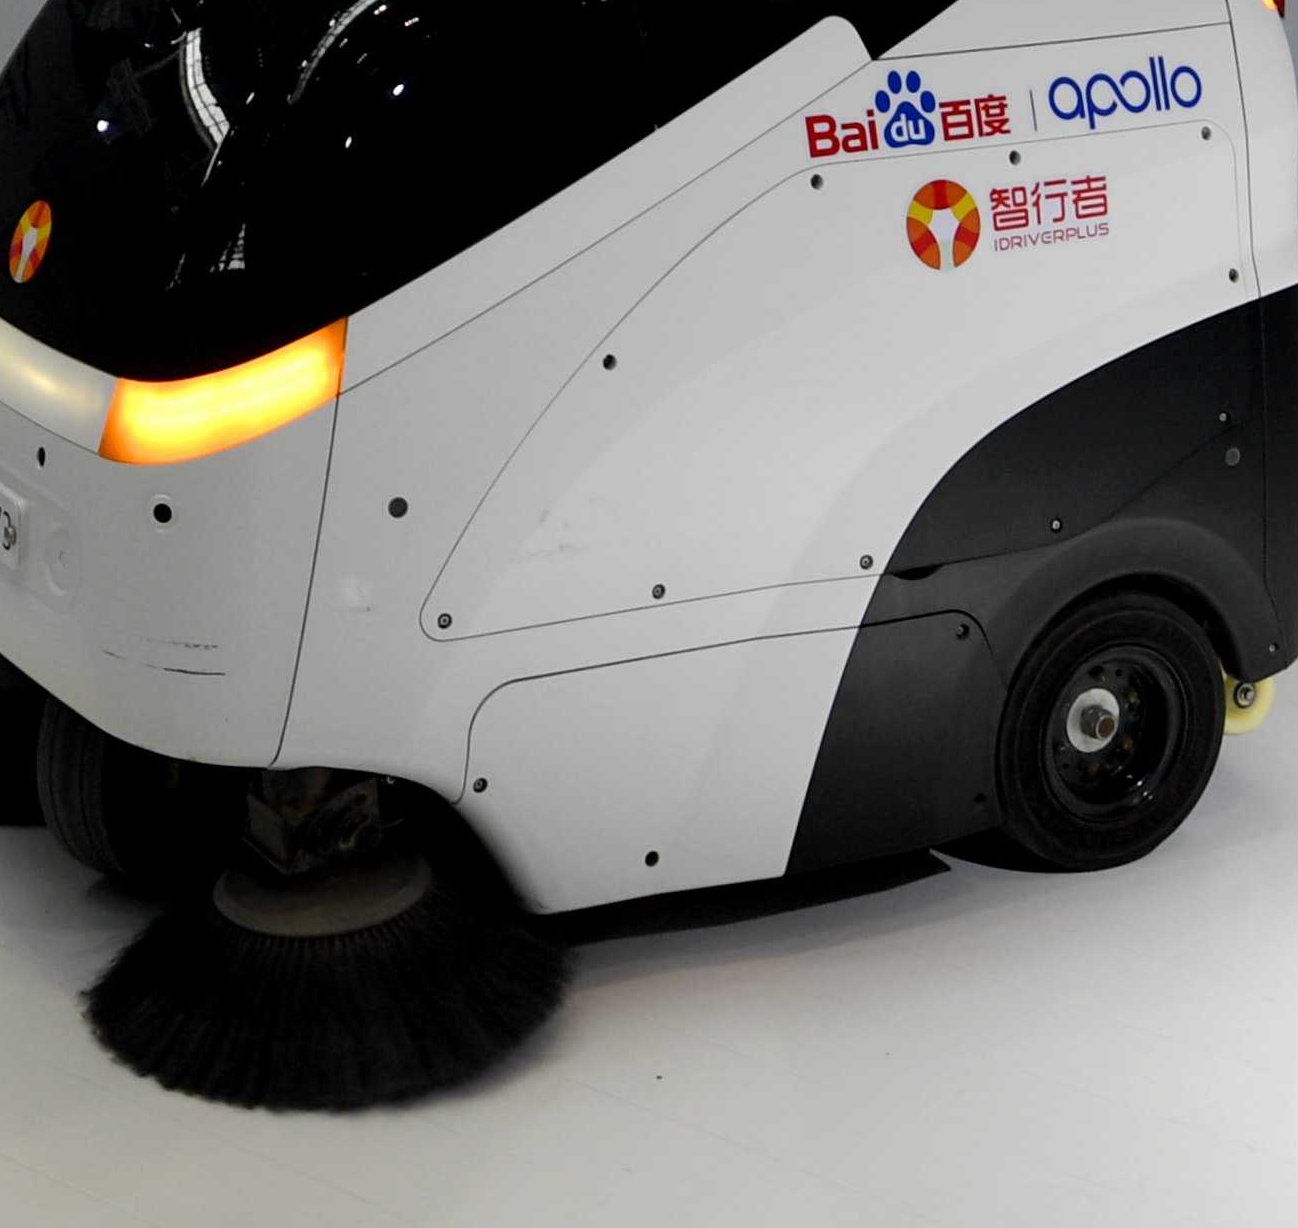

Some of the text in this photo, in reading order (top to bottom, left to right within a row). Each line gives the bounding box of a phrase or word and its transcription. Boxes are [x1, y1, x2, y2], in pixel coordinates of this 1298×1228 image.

[938, 93, 1012, 143] 百度
[1048, 55, 1202, 130] apollo
[988, 174, 1109, 233] 智行者
[993, 222, 1110, 253] IDRIVERPLUS
